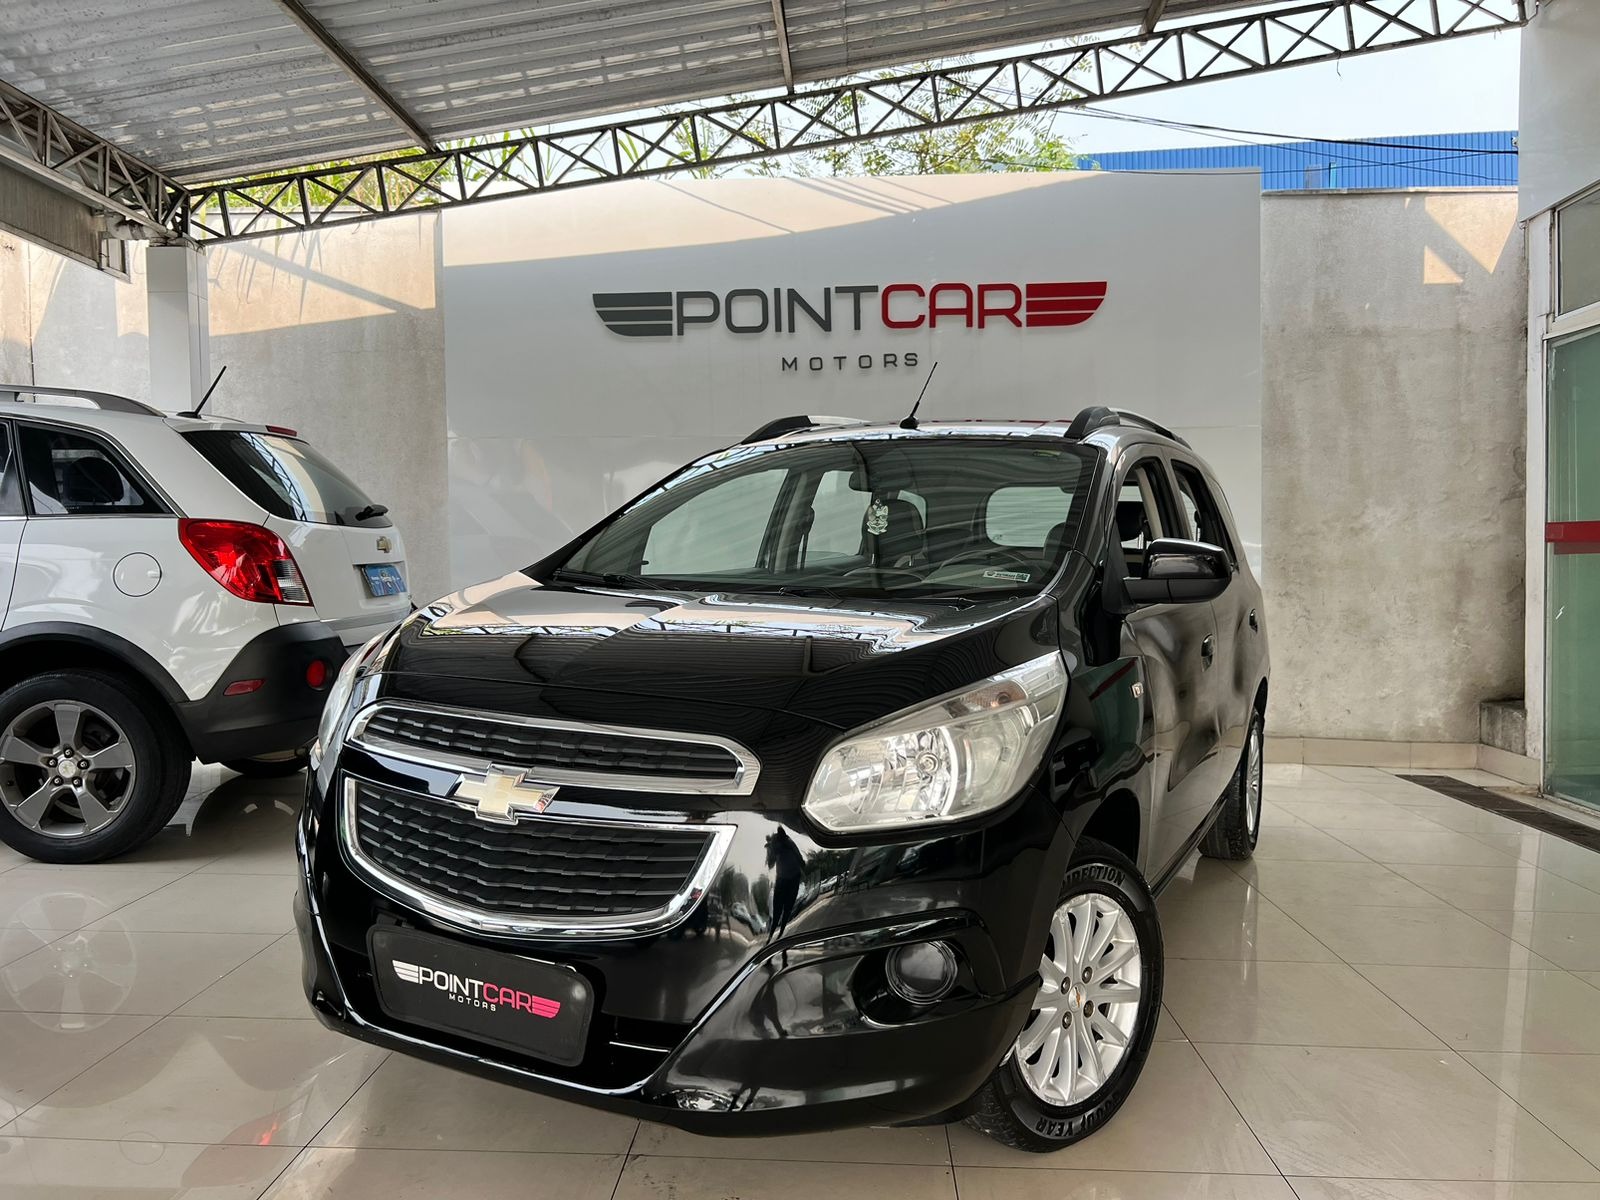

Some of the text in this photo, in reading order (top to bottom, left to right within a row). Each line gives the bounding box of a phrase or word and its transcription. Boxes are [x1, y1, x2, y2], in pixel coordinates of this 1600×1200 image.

[677, 283, 1022, 336] POINTCAR
[781, 352, 919, 371] MOTORS
[1062, 866, 1126, 889] IRECTION
[419, 966, 533, 1014] POINTCAR
[449, 993, 497, 1012] MOTORS
